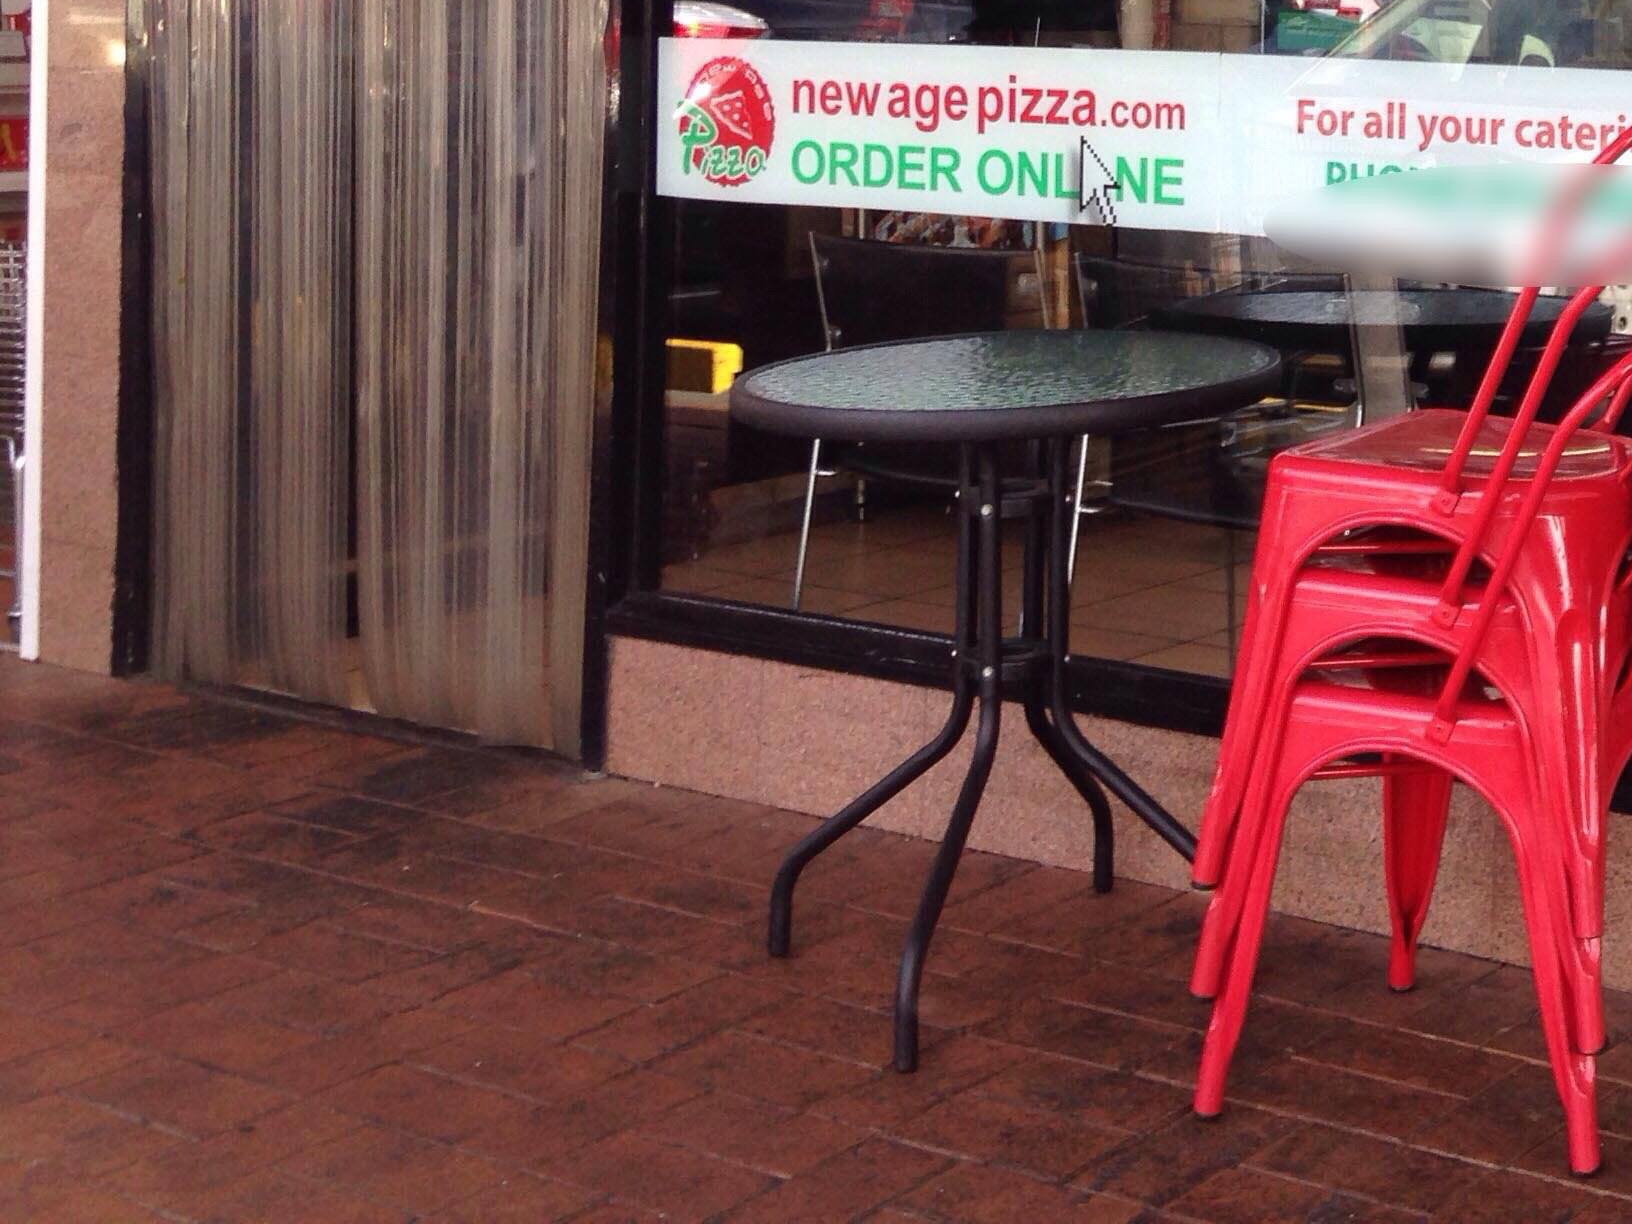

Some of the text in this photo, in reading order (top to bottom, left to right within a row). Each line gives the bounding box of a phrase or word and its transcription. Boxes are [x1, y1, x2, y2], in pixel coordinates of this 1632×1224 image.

[674, 99, 767, 176] Pizza
[1297, 99, 1354, 136] For
[1364, 100, 1407, 140] all
[1417, 114, 1505, 152] your
[792, 139, 1185, 206] ORDER ONLNE
